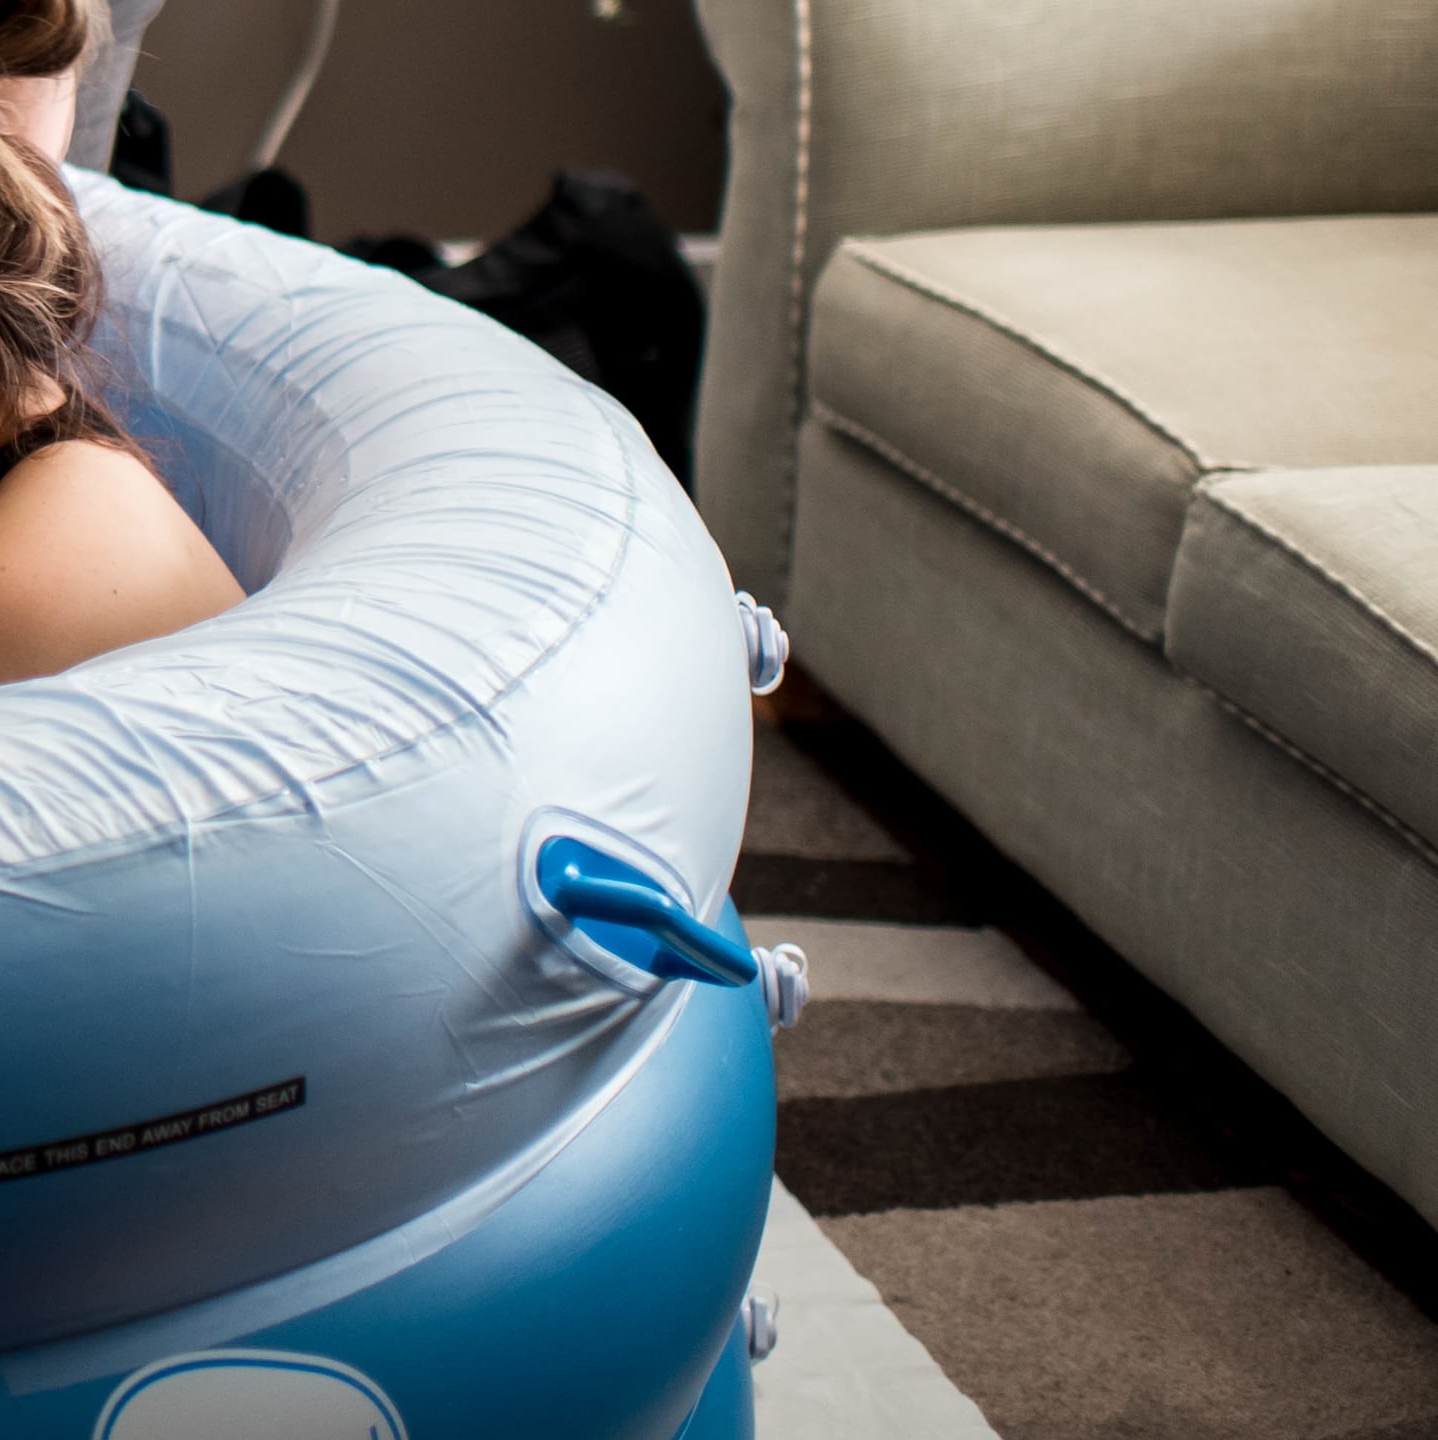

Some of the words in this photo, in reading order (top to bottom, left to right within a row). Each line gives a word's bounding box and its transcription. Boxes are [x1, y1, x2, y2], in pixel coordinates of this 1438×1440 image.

[44, 1143, 89, 1167] THIS
[95, 1132, 136, 1157] END
[141, 1118, 193, 1145] AWAY
[198, 1101, 251, 1130] FROM
[256, 1084, 300, 1113] SEAT
